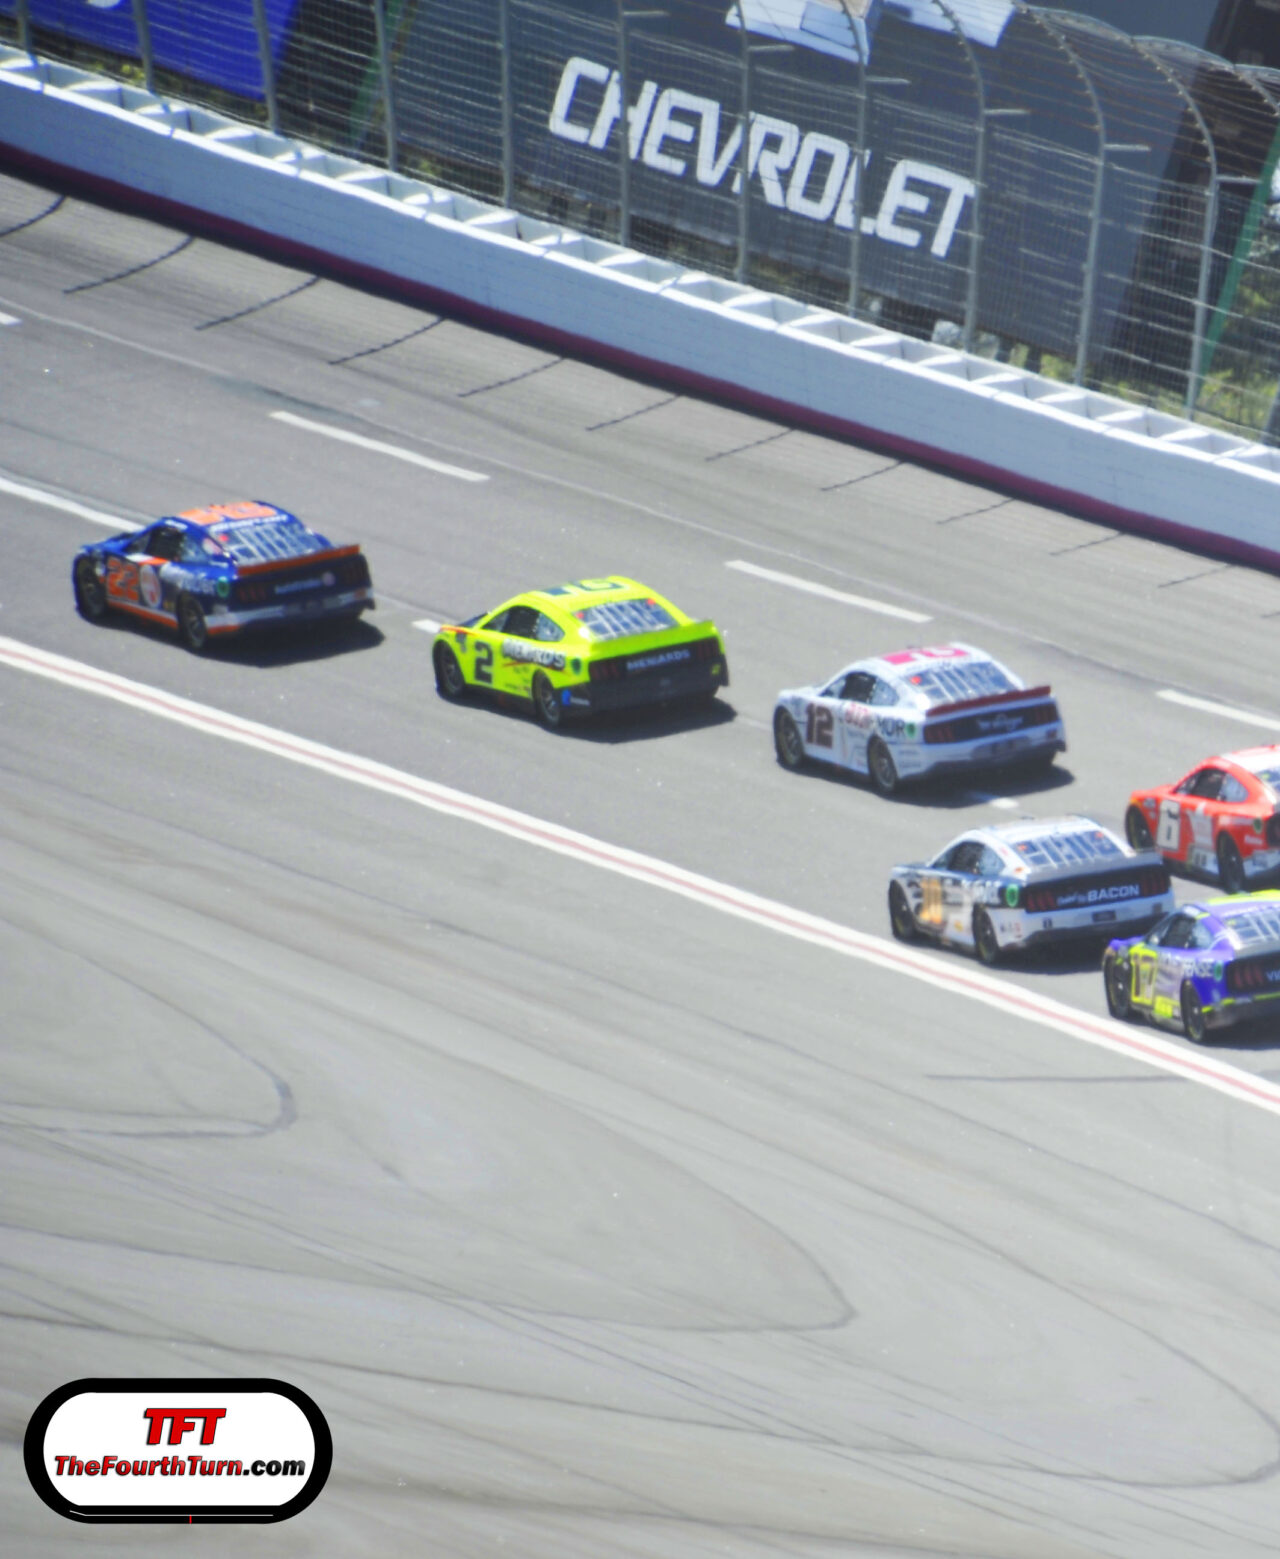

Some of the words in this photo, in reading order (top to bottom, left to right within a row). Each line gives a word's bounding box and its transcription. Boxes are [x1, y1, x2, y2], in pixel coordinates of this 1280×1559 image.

[549, 56, 977, 258] CHEVROLET
[107, 558, 140, 601] 22
[474, 640, 493, 684] 2
[626, 649, 690, 671] MENARDS
[806, 702, 834, 749] 12
[1087, 884, 1141, 903] BACON
